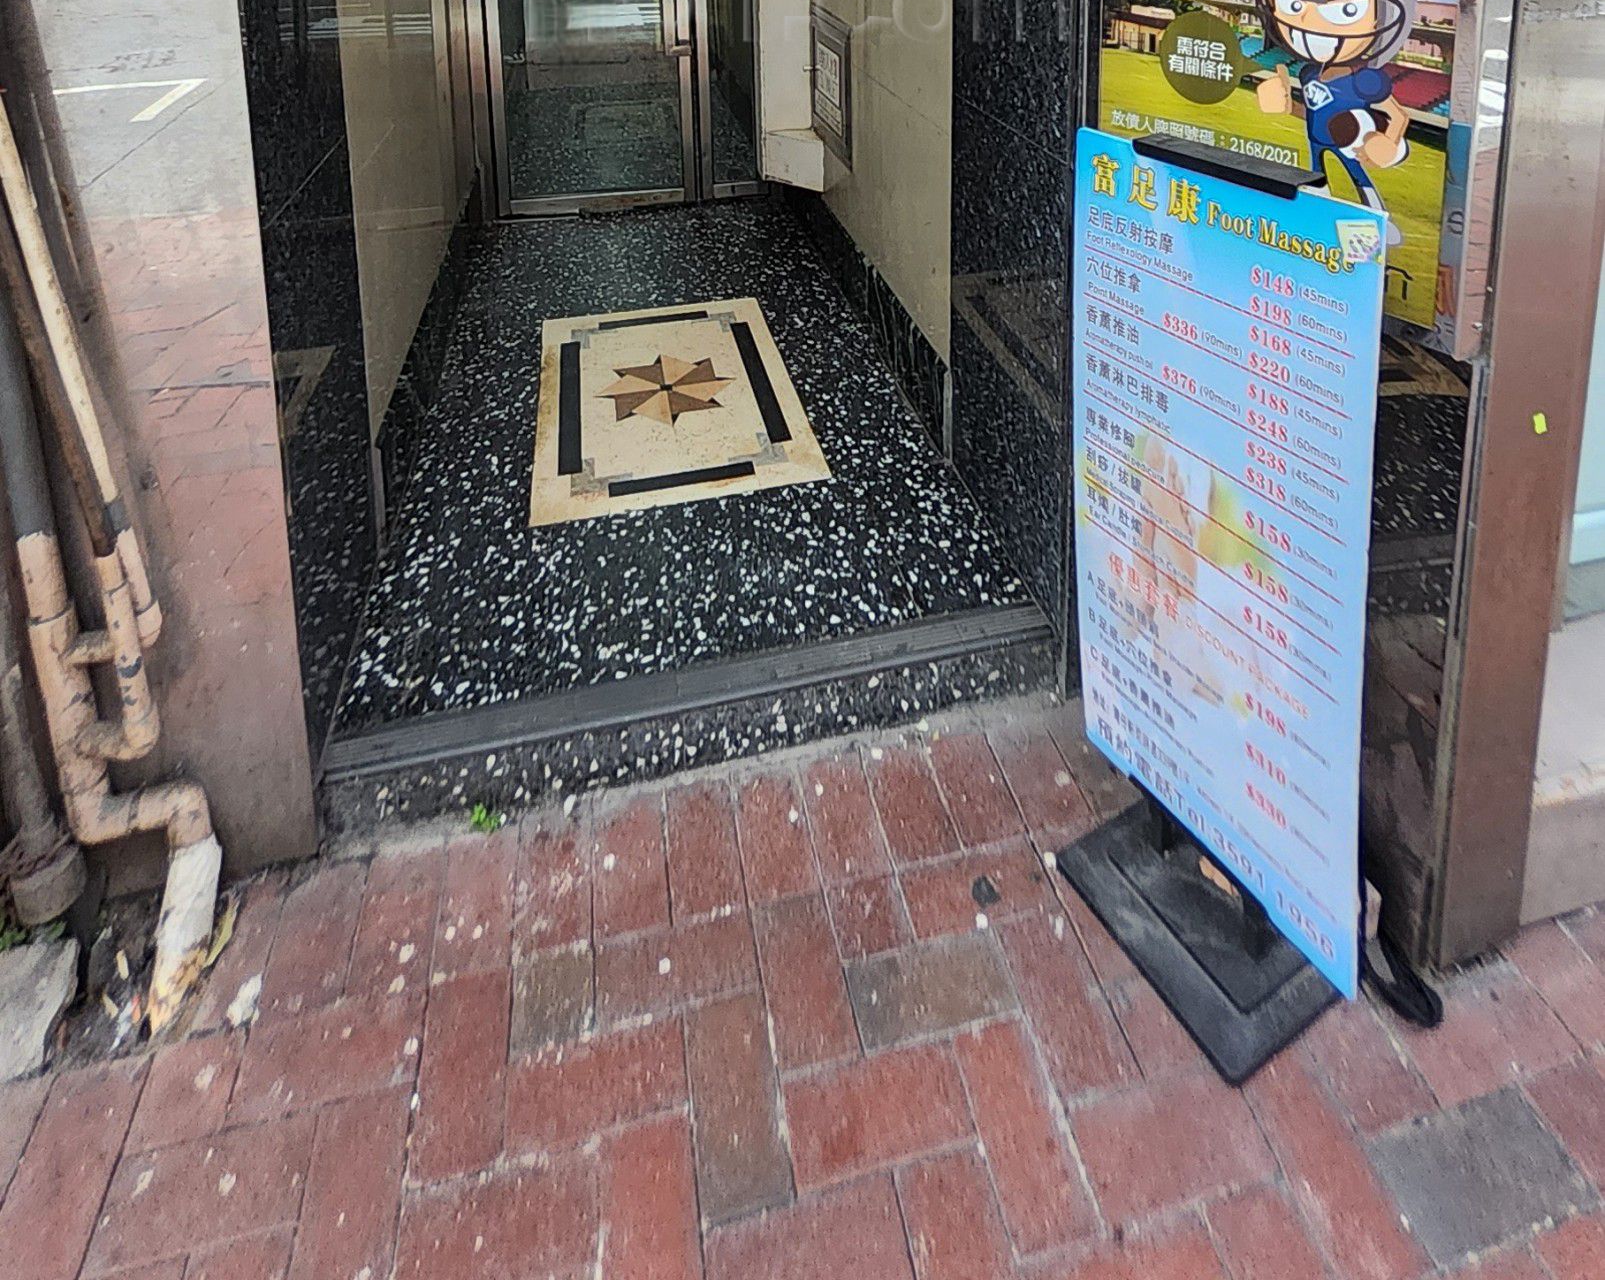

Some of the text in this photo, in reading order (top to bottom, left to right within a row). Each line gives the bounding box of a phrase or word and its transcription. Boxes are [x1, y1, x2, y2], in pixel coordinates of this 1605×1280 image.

[1168, 53, 1234, 82] 有關條件
[1176, 35, 1227, 62] 需符合
[1094, 153, 1199, 224] 富足康
[1208, 202, 1252, 239] Foot
[1089, 206, 1347, 314] 足底反射按摩 $148 (45mins)
[1087, 254, 1345, 377] 穴位推拿 $168 (45mins)
[1251, 294, 1291, 327] $198
[1298, 312, 1347, 343] (60mins)
[1164, 312, 1197, 341] $336
[1249, 350, 1289, 384] $220
[1296, 373, 1344, 406] (60mins)
[1163, 364, 1196, 395] $376
[1247, 408, 1287, 443] $248
[1294, 435, 1341, 469] (60mins)
[1248, 383, 1288, 416] $188
[1294, 405, 1342, 440] (45mins)
[1247, 440, 1286, 475] $238
[1247, 466, 1285, 502] $318
[1245, 509, 1290, 553] $158
[1244, 560, 1288, 605] $158
[1243, 604, 1287, 650] $158
[1245, 693, 1285, 736] $198
